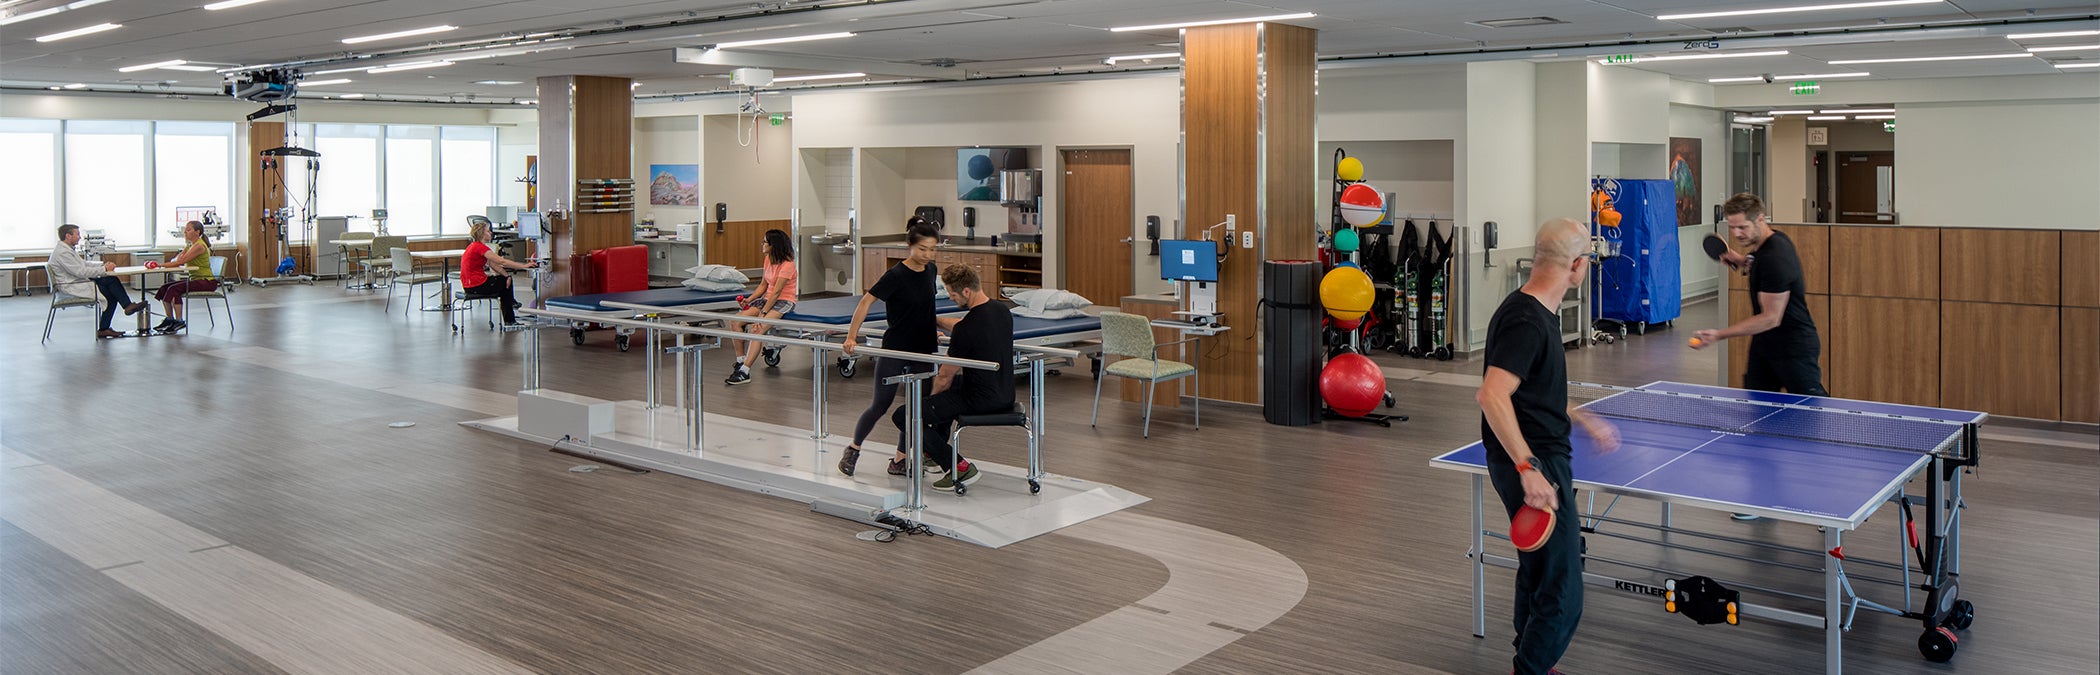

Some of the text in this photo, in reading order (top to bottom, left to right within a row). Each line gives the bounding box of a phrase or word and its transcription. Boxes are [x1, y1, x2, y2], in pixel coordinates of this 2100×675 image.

[1683, 40, 1719, 49] ZeroG
[1795, 81, 1816, 95] EXIT
[1615, 580, 1665, 597] KETTLER
